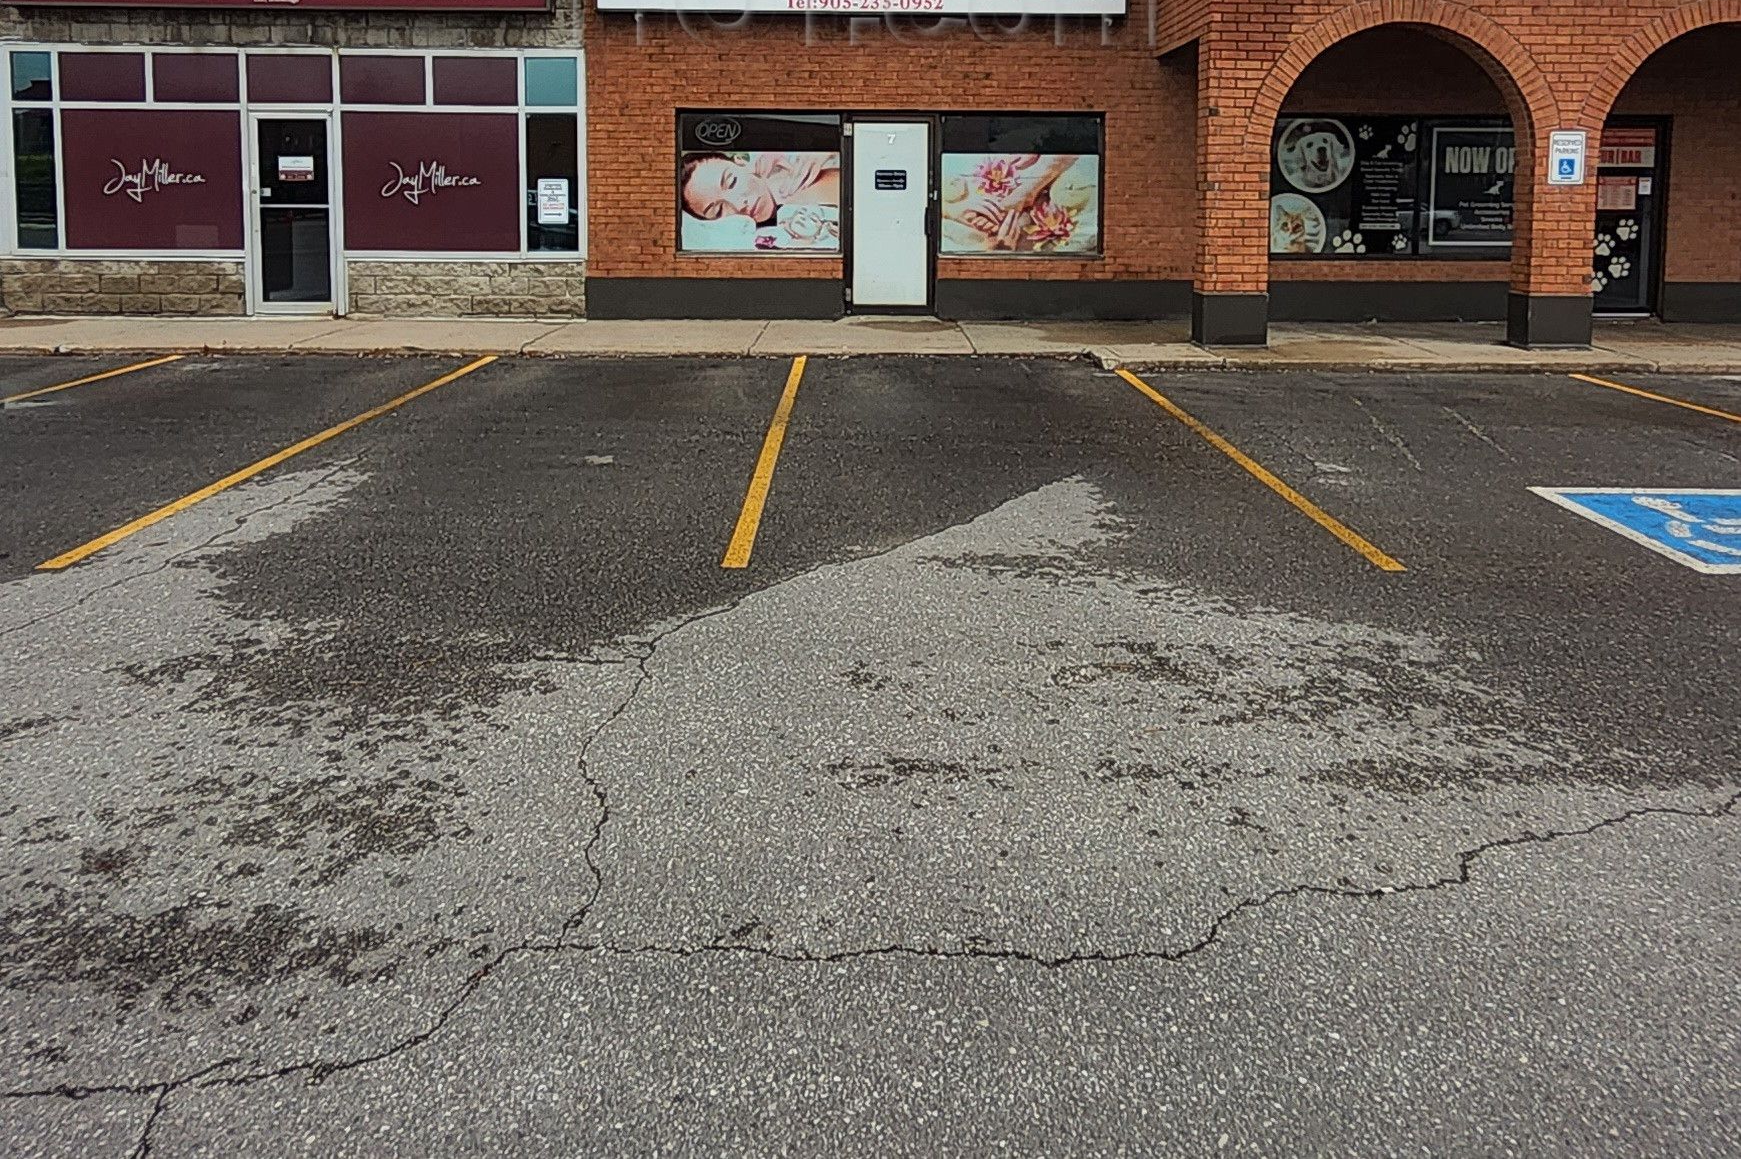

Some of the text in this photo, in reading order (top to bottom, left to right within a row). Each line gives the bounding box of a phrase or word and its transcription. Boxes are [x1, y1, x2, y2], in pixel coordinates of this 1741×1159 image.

[698, 123, 737, 138] OPEN
[887, 133, 896, 144] 7
[1445, 146, 1491, 174] NOW
[103, 158, 206, 203] JayMiller.ca
[381, 160, 482, 205] JayMiller.ca
